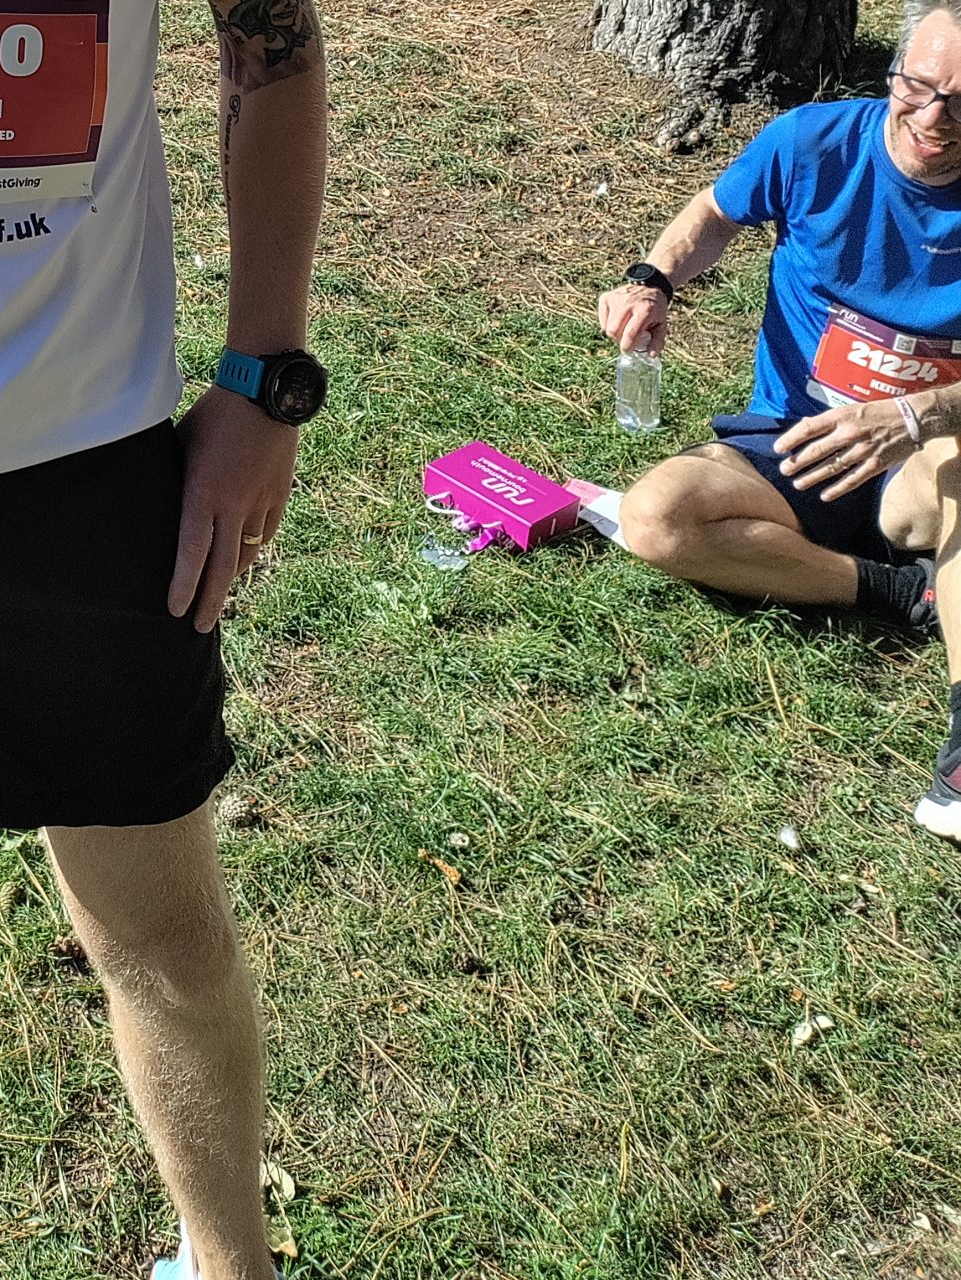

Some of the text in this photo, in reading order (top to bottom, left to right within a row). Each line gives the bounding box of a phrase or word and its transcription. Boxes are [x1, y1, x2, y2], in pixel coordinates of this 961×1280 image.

[839, 309, 859, 323] run
[847, 340, 939, 382] 21224
[869, 379, 907, 396] KEITH
[481, 477, 536, 506] run
